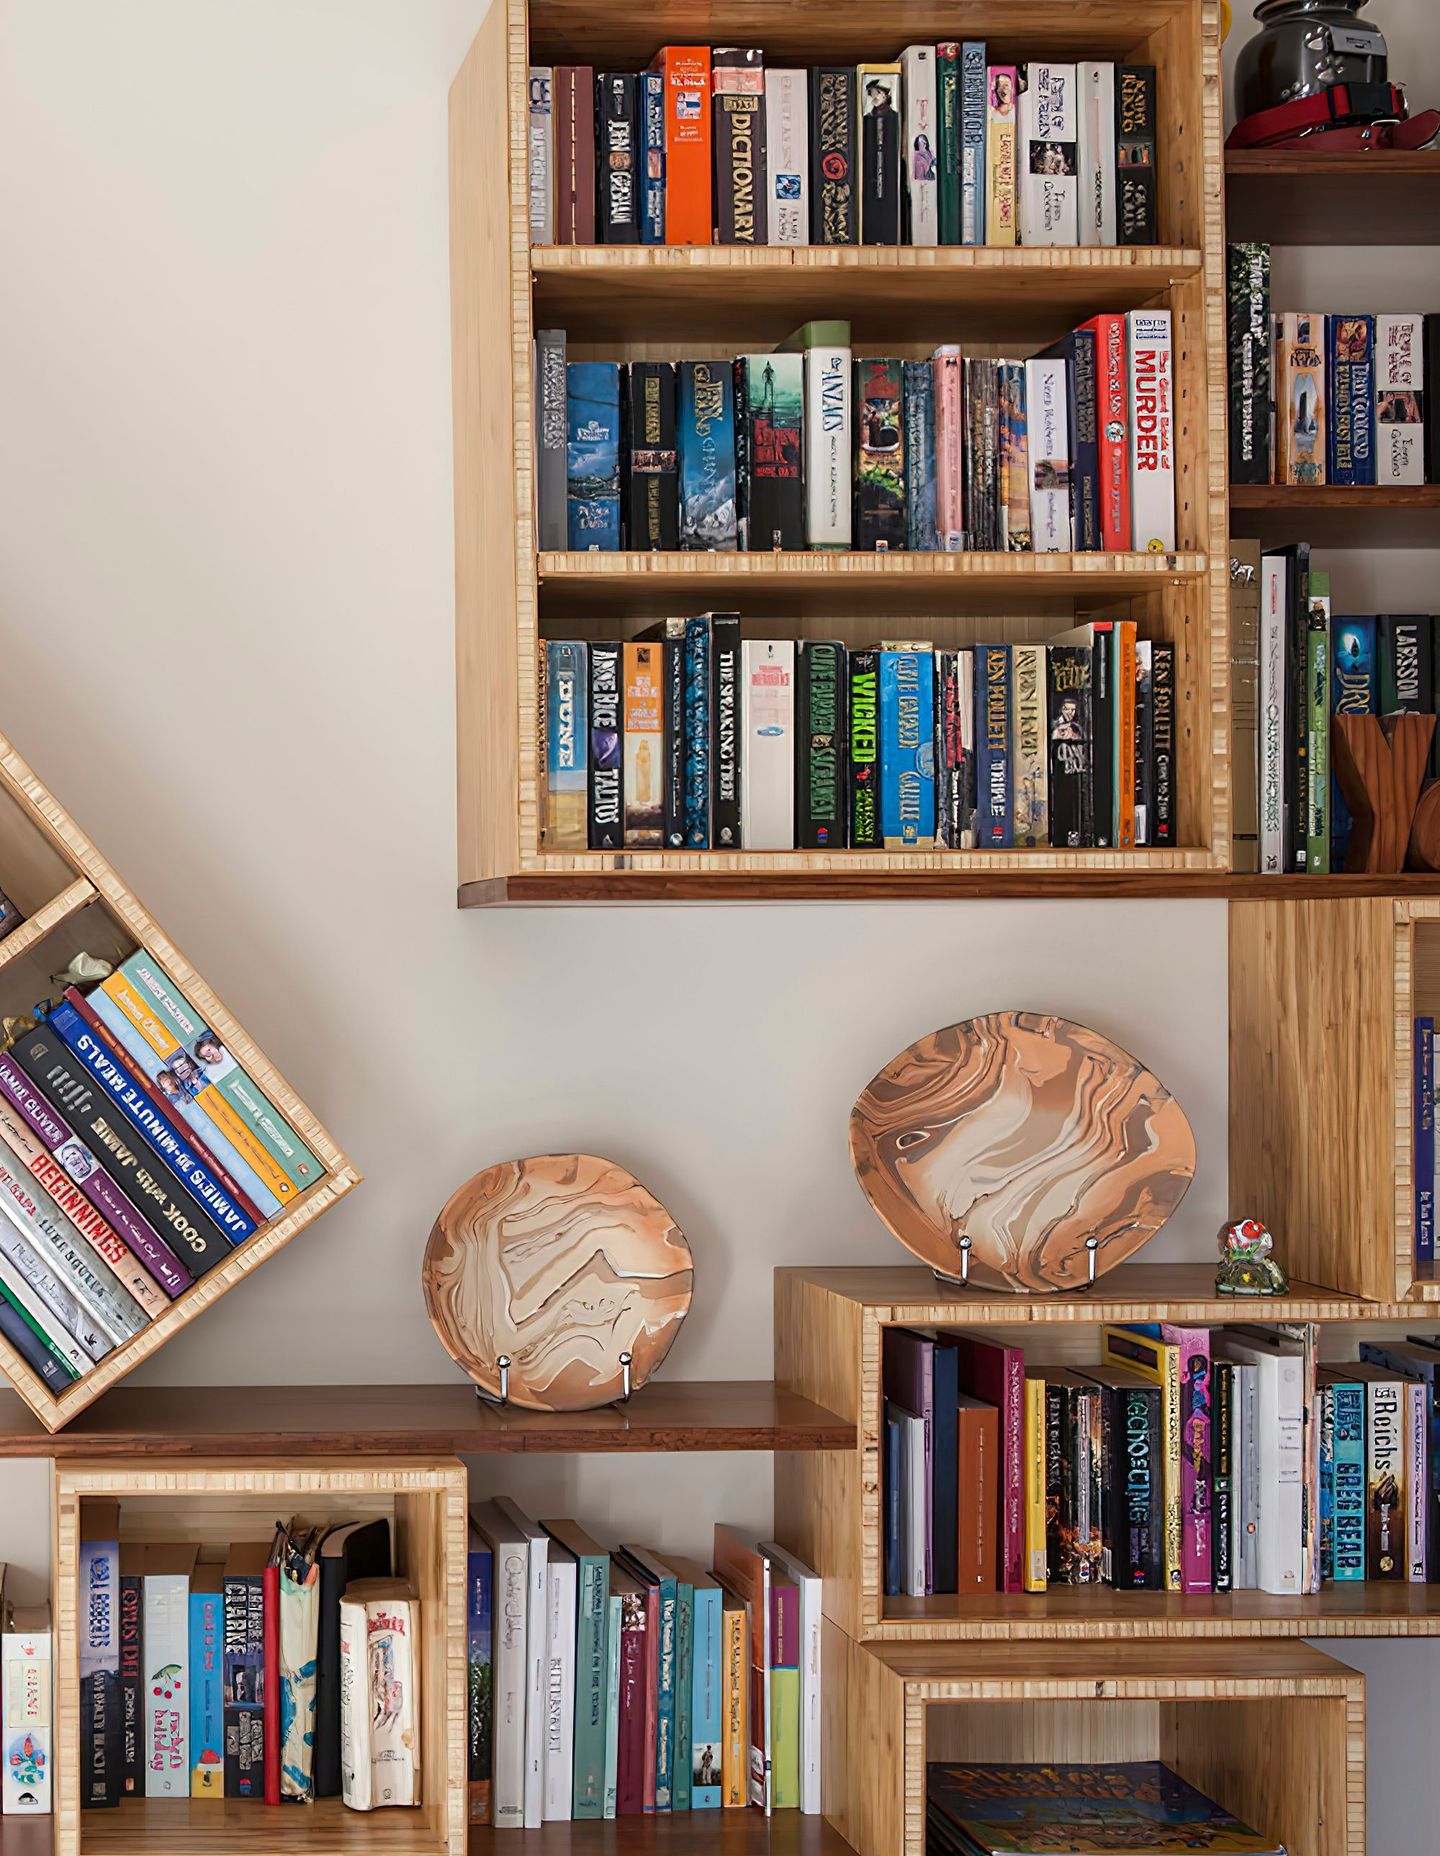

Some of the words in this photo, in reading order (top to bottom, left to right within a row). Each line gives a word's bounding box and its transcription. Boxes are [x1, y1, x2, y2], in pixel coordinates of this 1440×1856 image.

[731, 114, 755, 242] DICTIONARY
[1135, 350, 1158, 472] MURDER
[1396, 625, 1418, 700] LARSSON
[559, 679, 575, 768] DUNE
[851, 671, 877, 763] WICKED
[73, 1032, 128, 1095] MEALS
[27, 1150, 130, 1268] BEGINNINGS
[160, 1200, 211, 1257] COOK
